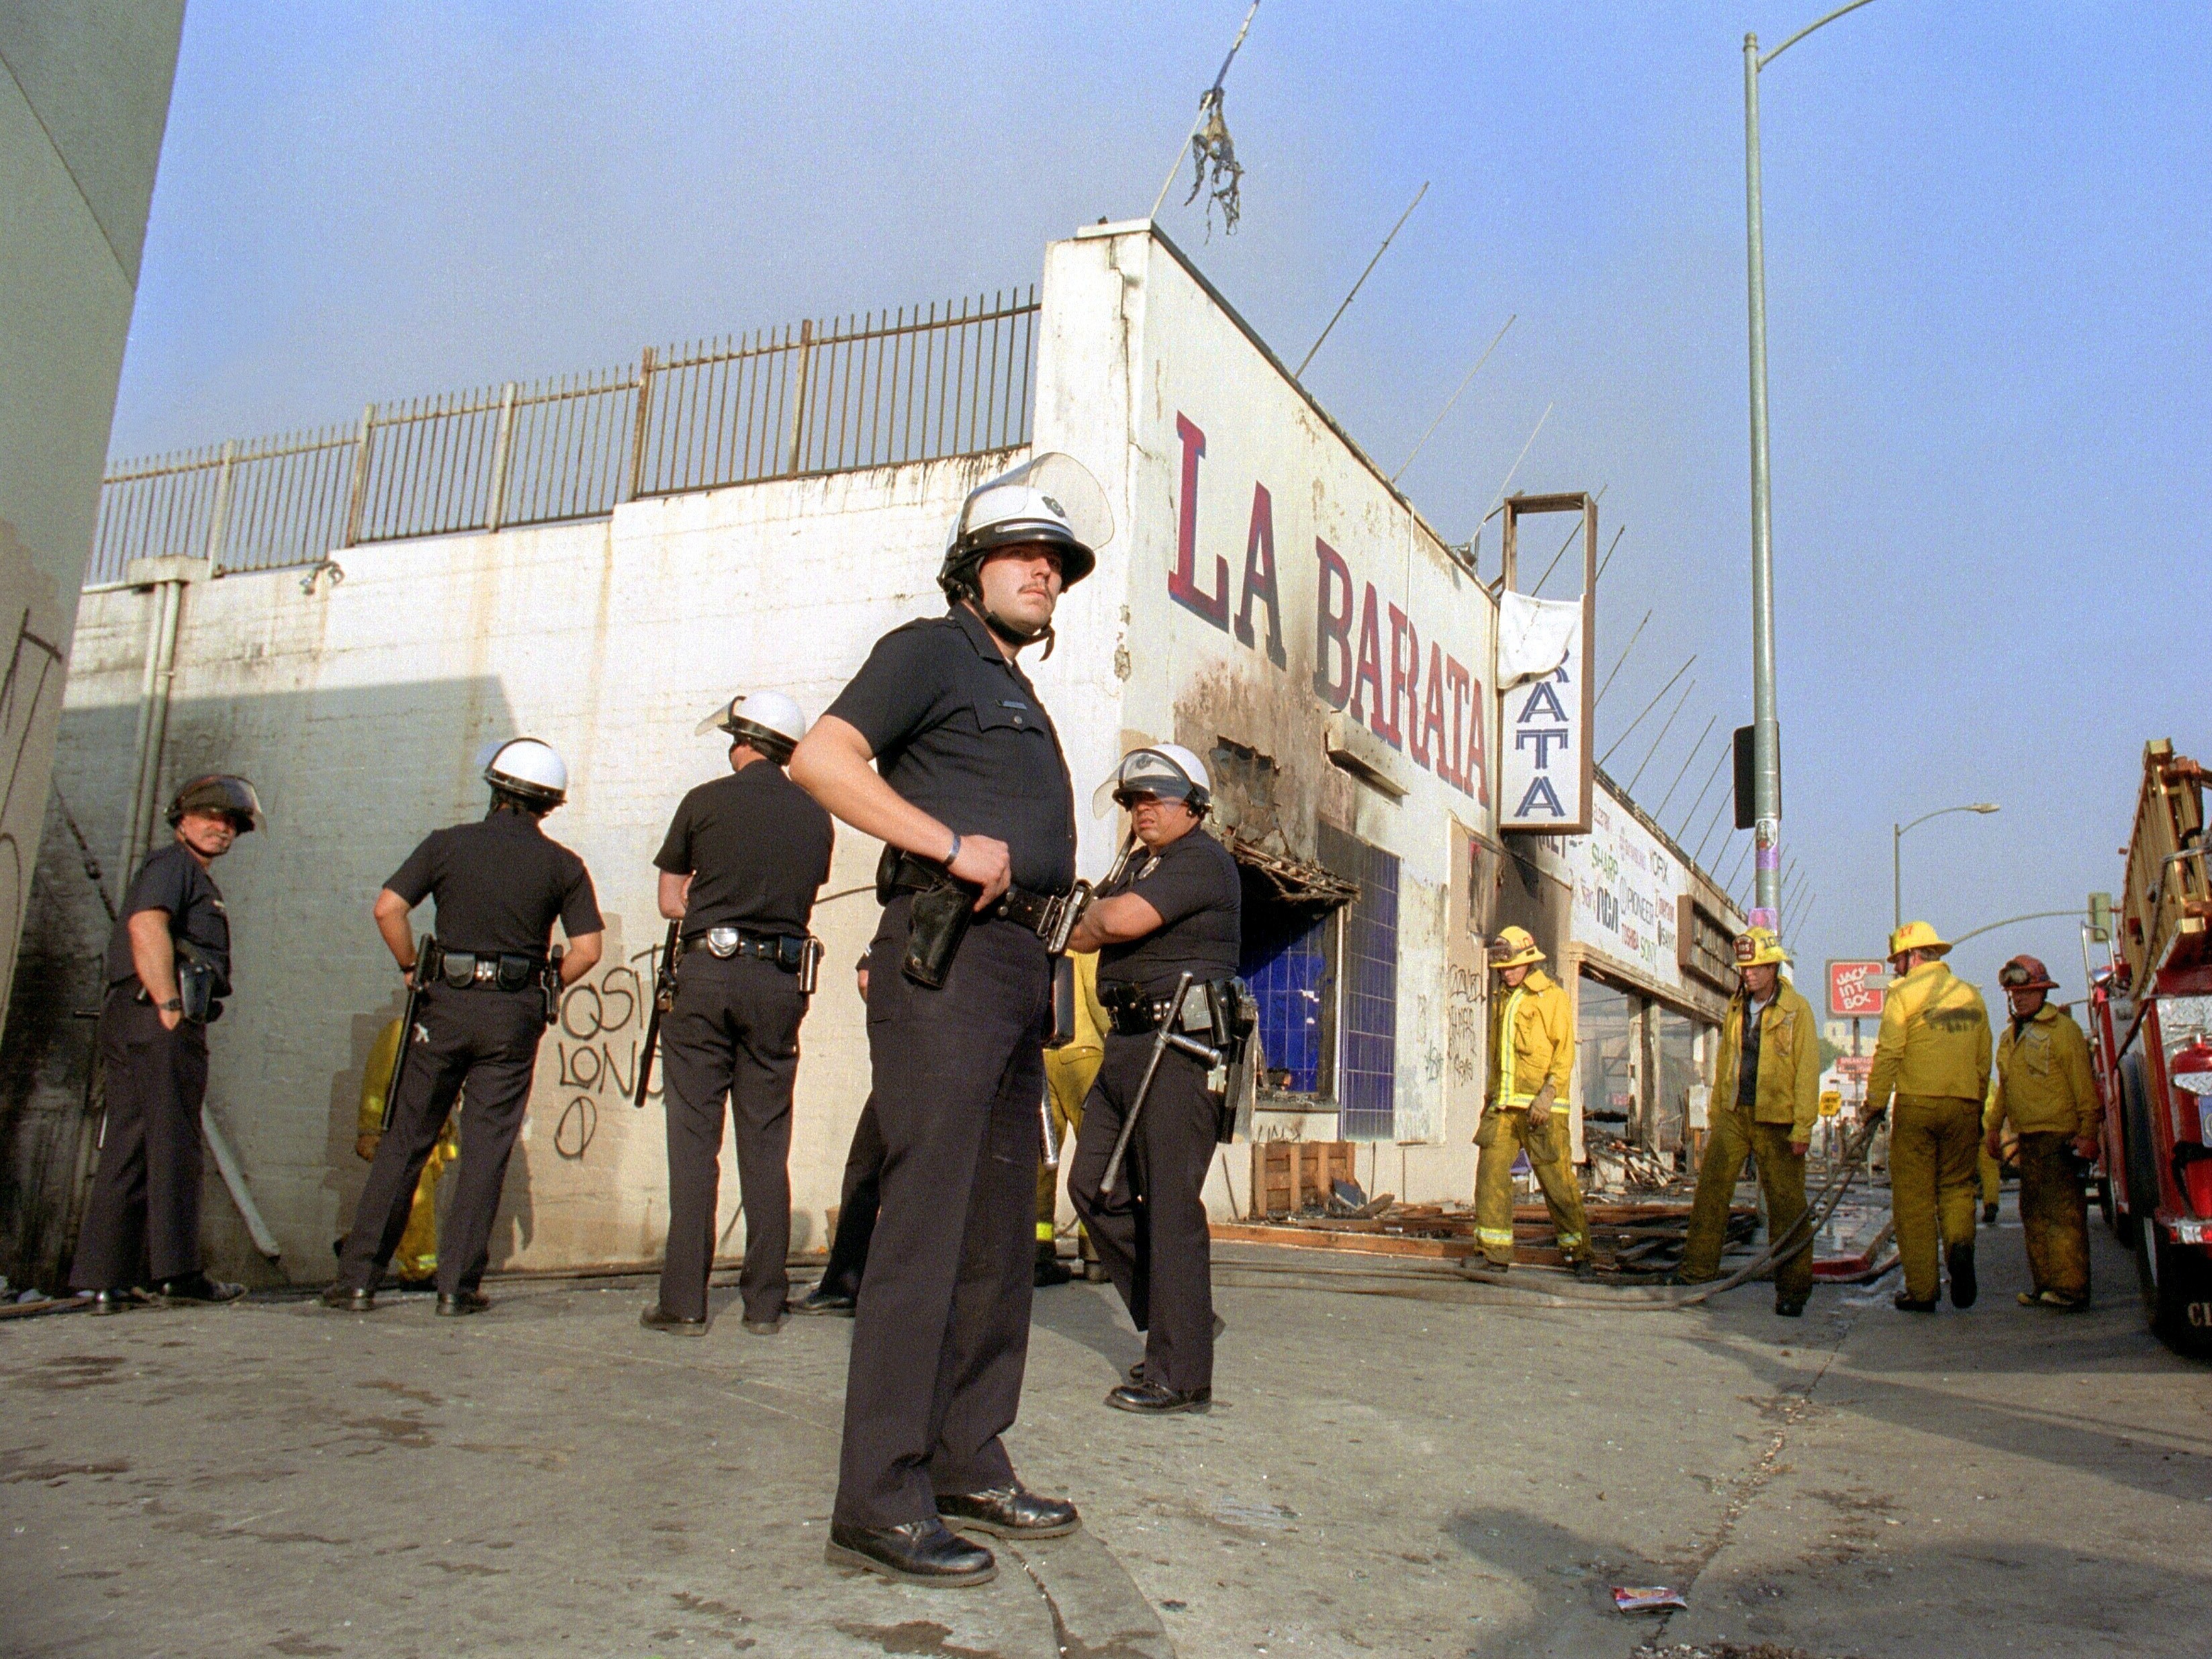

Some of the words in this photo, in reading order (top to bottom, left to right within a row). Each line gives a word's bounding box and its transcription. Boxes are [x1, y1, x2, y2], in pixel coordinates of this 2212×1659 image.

[1168, 409, 1287, 671] LA
[1312, 535, 1490, 809] BARATA
[1514, 649, 1569, 817] ATA
[1843, 991, 1871, 1010] BOX
